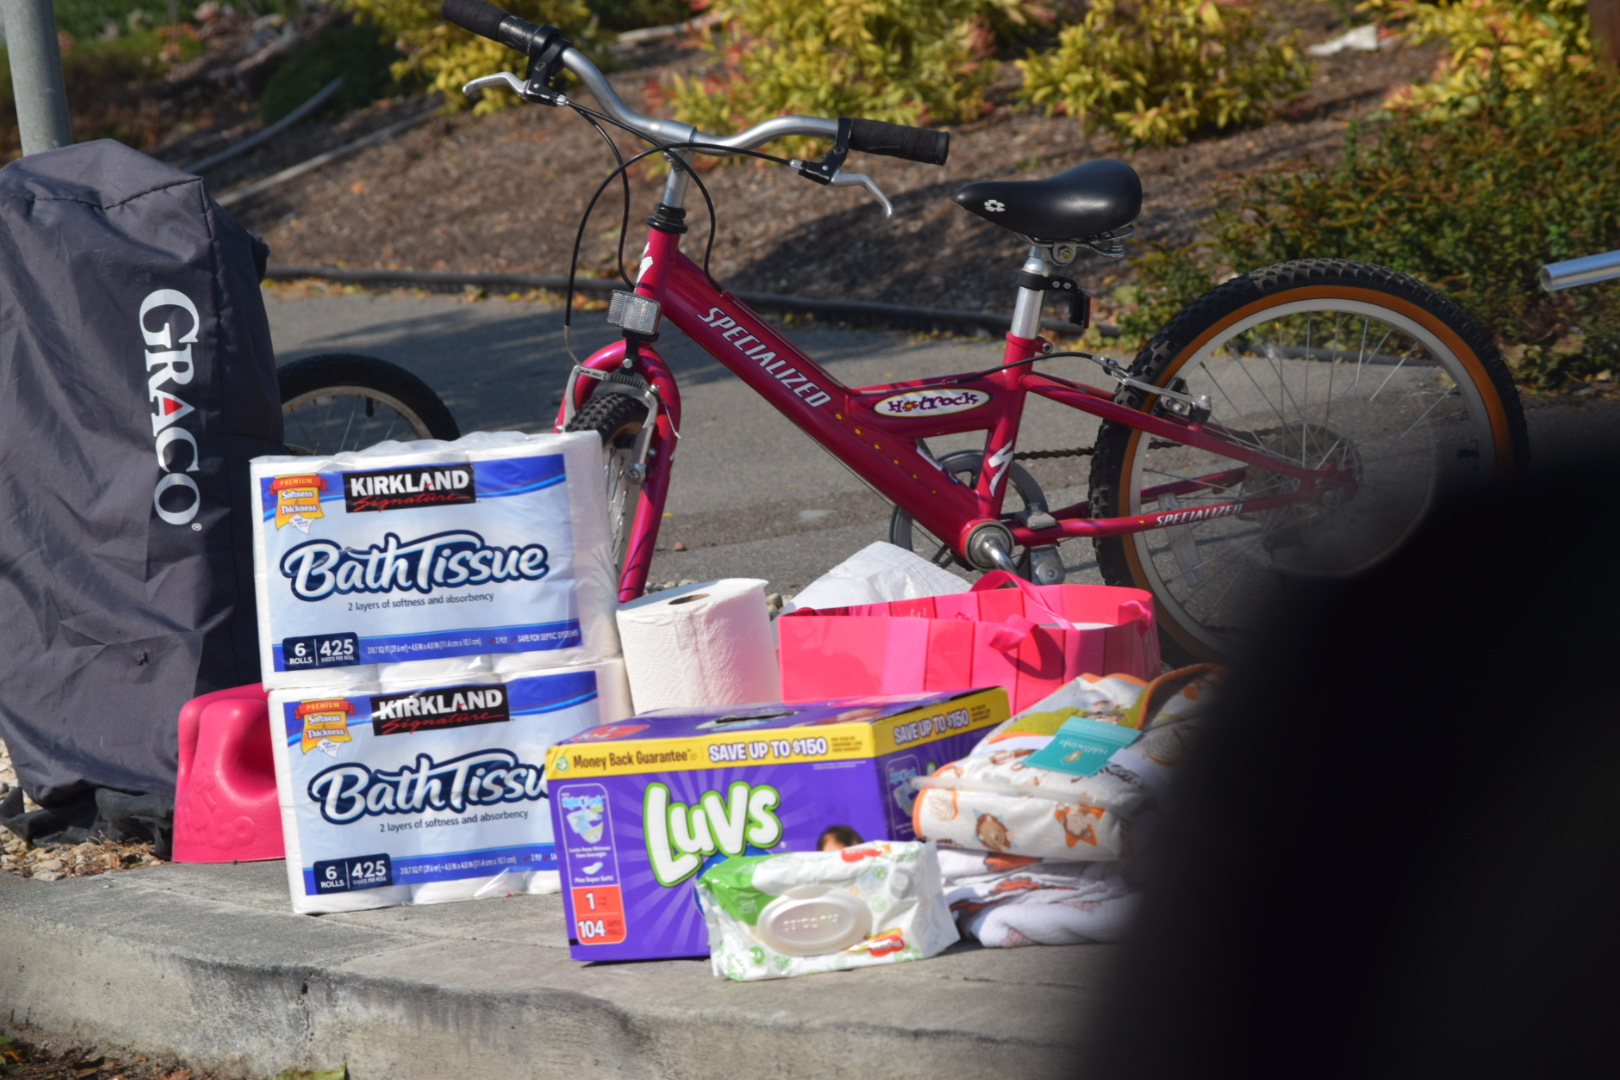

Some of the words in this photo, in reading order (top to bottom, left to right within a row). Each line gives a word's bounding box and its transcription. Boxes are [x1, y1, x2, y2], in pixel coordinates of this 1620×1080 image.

[697, 307, 832, 408] SPECIALIZED
[139, 288, 201, 526] GRACO
[279, 477, 313, 486] PREMIUM
[350, 469, 470, 497] KIRKLAND
[281, 489, 315, 501] Softness
[352, 492, 472, 513] Signature
[280, 504, 318, 515] Thickness
[1154, 502, 1244, 528] SPECIALIZED
[348, 602, 353, 611] 2
[355, 600, 380, 612] layers
[382, 599, 390, 609] of
[392, 597, 426, 608] softness
[428, 594, 444, 605] and
[446, 592, 494, 604] absorbency
[294, 642, 307, 657] 6
[319, 638, 354, 656] 425
[289, 656, 313, 665] ROLLS
[306, 702, 340, 711] PREMIUM
[378, 689, 503, 720] KIRKLAND
[308, 714, 342, 724] Softness
[380, 711, 505, 735] Signature
[892, 721, 919, 745] SAVE
[918, 717, 933, 738] UP
[932, 714, 946, 733] TO
[946, 708, 970, 728] $150
[307, 728, 345, 739] Thickness
[708, 742, 747, 762] SAVE
[748, 740, 769, 759] UP
[770, 739, 790, 758] TO
[792, 737, 828, 756] $150
[573, 754, 607, 771] Money
[609, 751, 634, 767] Back
[379, 823, 385, 833] 2
[387, 821, 412, 833] layers
[414, 819, 423, 829] of
[424, 817, 459, 828] softness
[461, 812, 478, 824] and
[480, 809, 528, 822] absorbency
[325, 866, 338, 880] 6
[351, 860, 387, 878] 425
[320, 880, 345, 889] ROLLS
[585, 891, 596, 911] 1
[577, 919, 606, 939] 104
